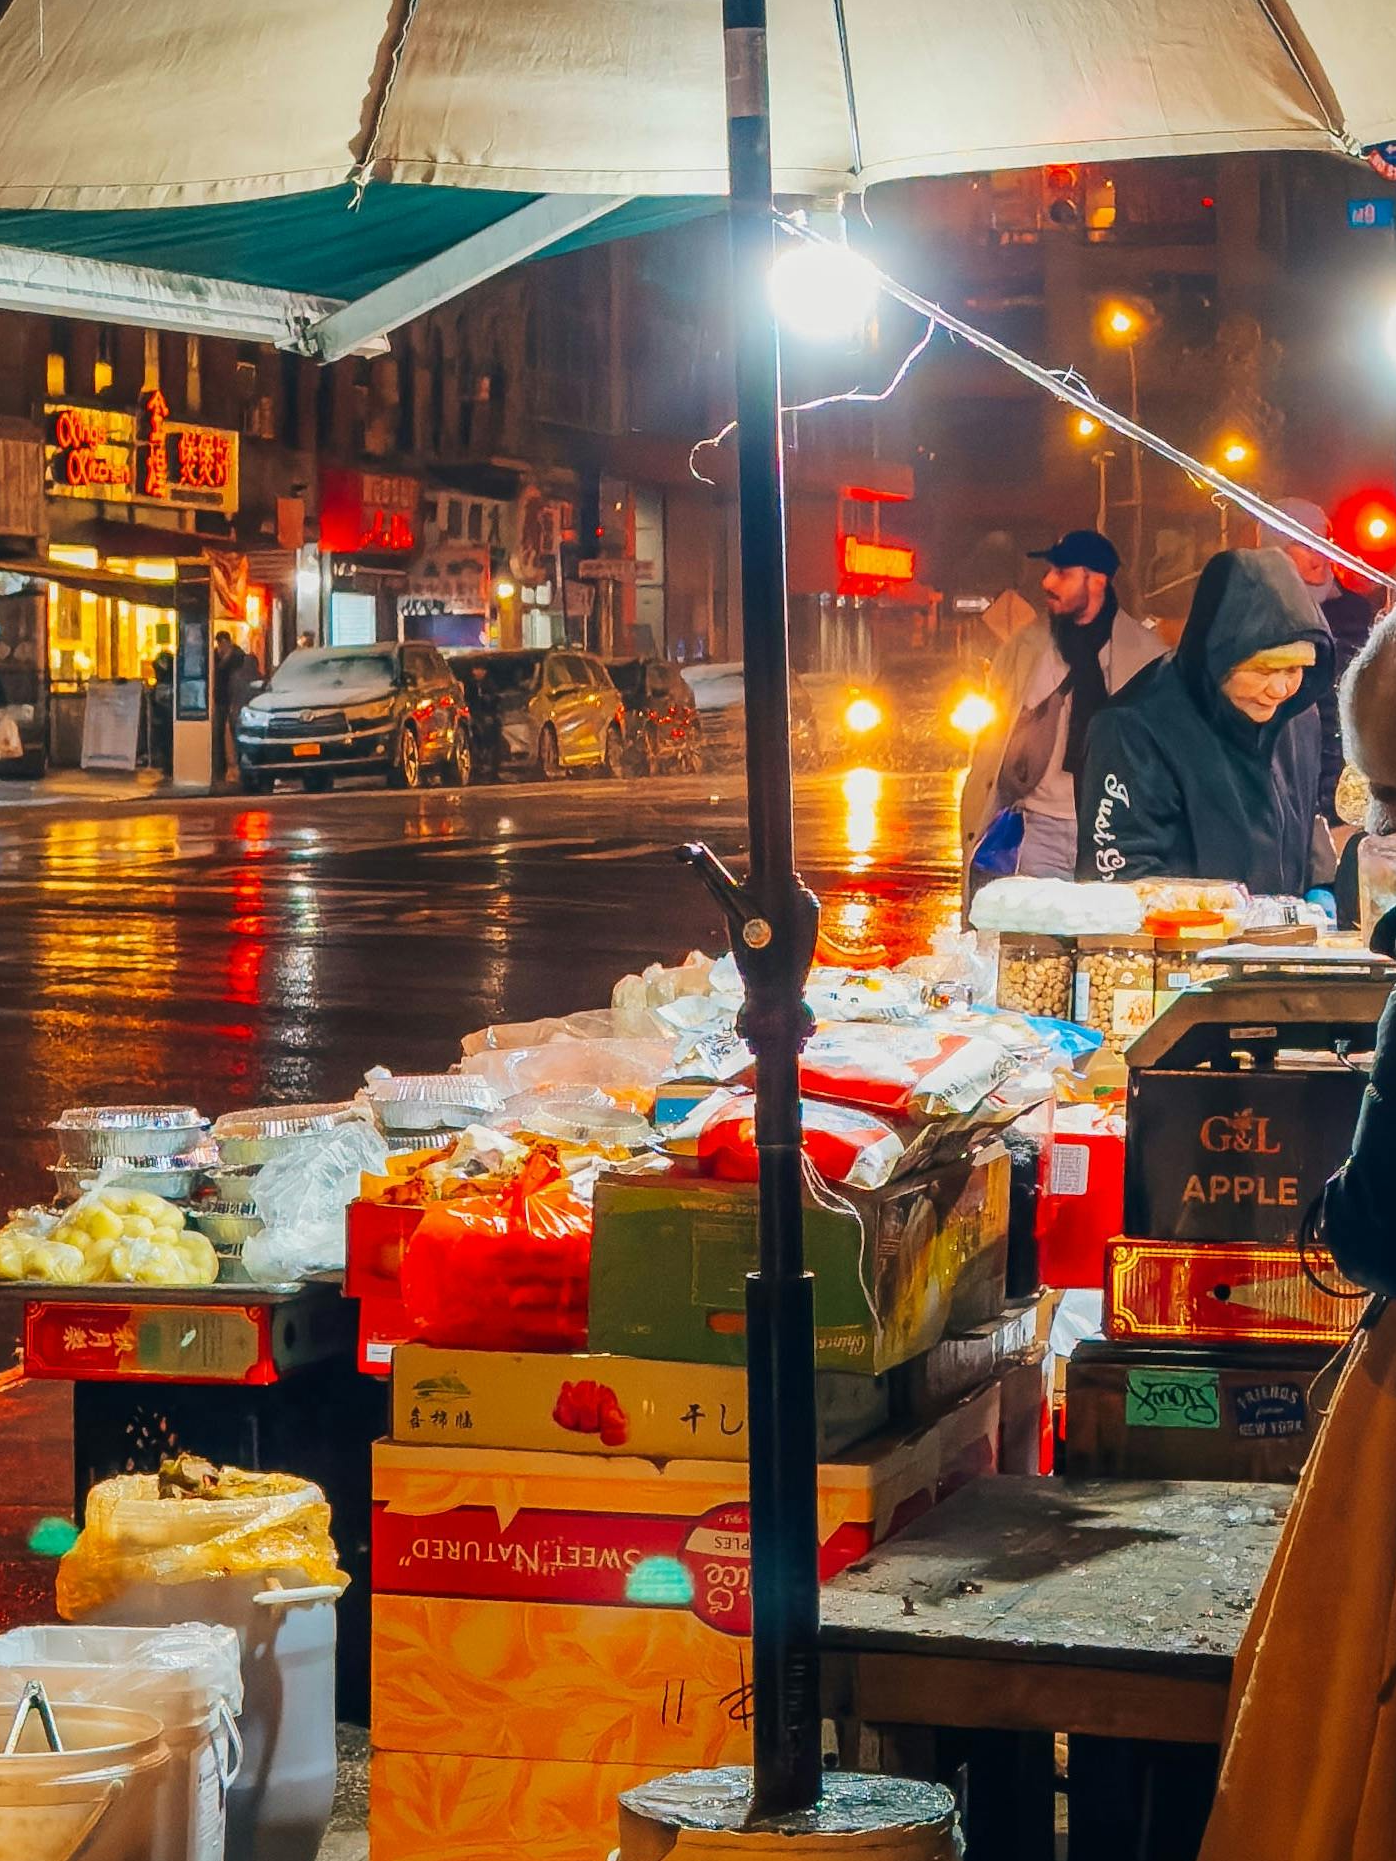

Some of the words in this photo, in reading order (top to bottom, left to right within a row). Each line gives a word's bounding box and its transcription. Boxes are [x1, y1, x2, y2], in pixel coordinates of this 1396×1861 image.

[1093, 773, 1130, 846] Just
[1200, 1114, 1282, 1154] G&L
[1181, 1174, 1298, 1206] APPLE
[1237, 1385, 1300, 1409] FRIENDS
[1239, 1420, 1266, 1437] NEW
[1272, 1419, 1304, 1435] YORK
[714, 1534, 749, 1550] PLES
[704, 1563, 750, 1594] ice
